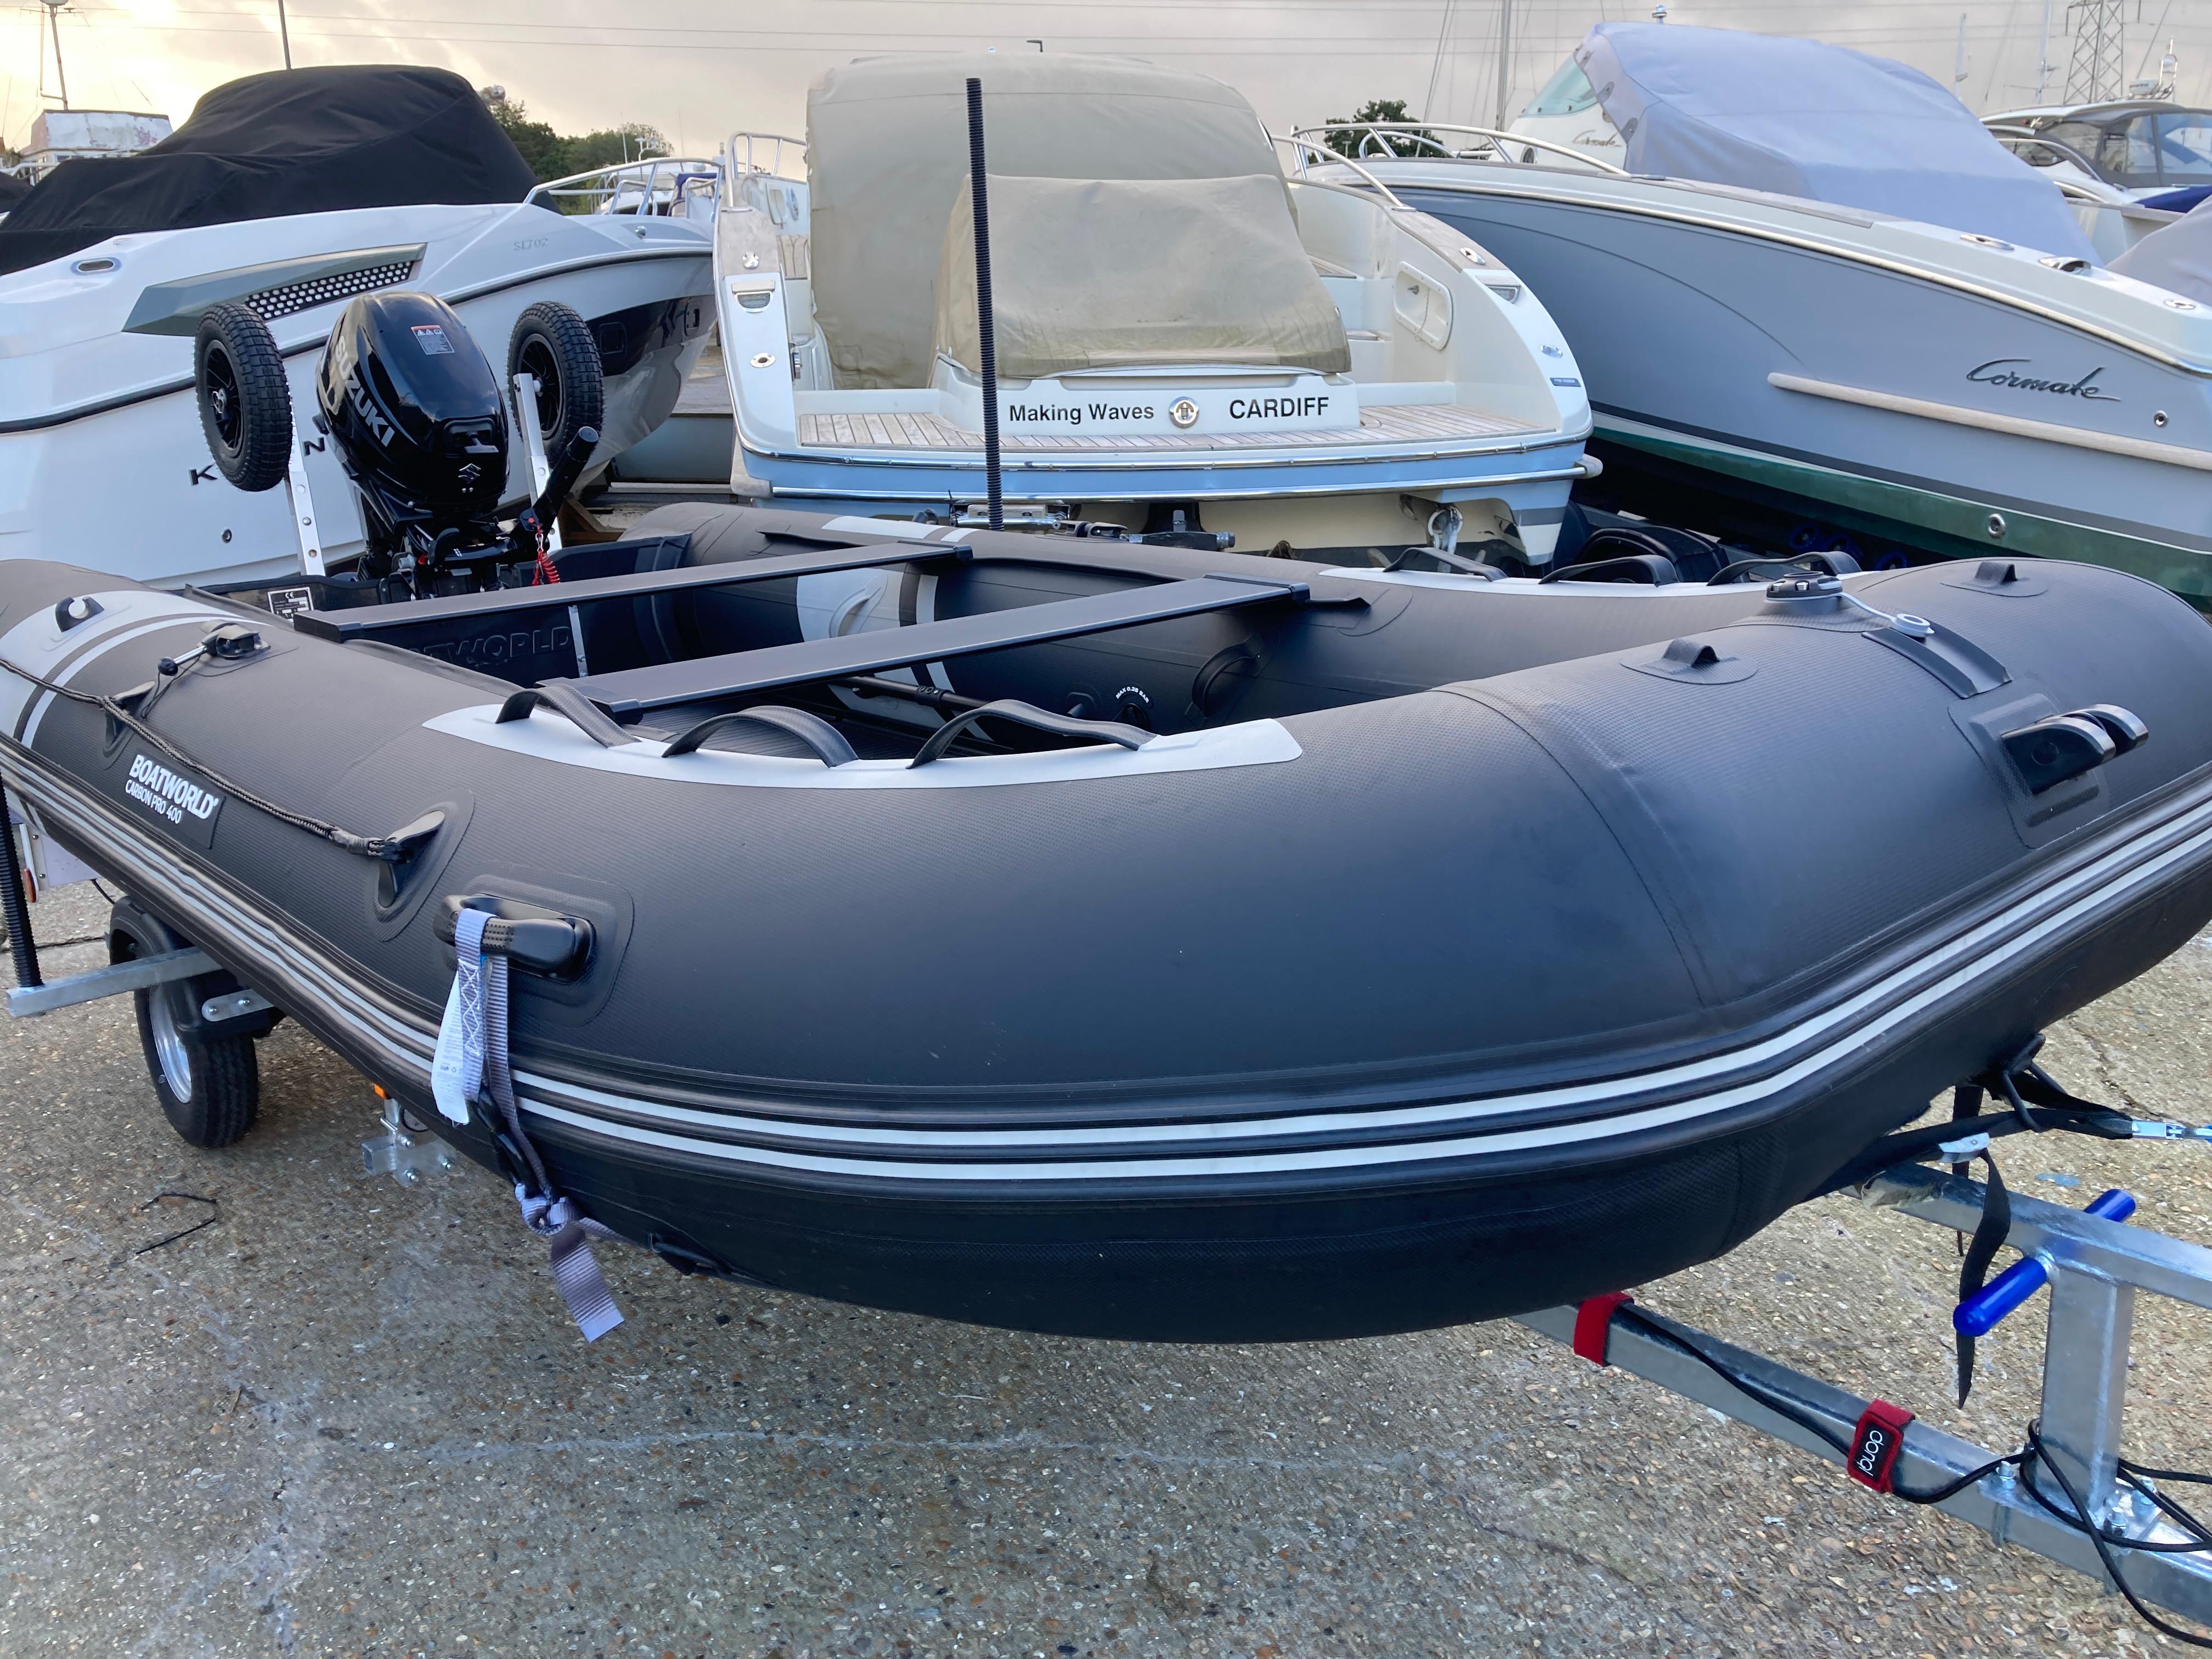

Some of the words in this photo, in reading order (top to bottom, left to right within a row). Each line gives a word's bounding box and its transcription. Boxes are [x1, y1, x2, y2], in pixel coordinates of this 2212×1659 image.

[335, 335, 395, 447] SUZUKI
[1229, 397, 1329, 419] CARDIFF
[1009, 404, 1081, 425] Making
[1088, 403, 1154, 420] Waves
[409, 626, 570, 665] TWORLD
[1115, 687, 1127, 699] MAX
[1139, 690, 1149, 703] BAR
[125, 779, 153, 806] CARBON
[150, 794, 167, 815] PRO
[166, 805, 182, 824] 400
[129, 754, 215, 819] BOATWORLD
